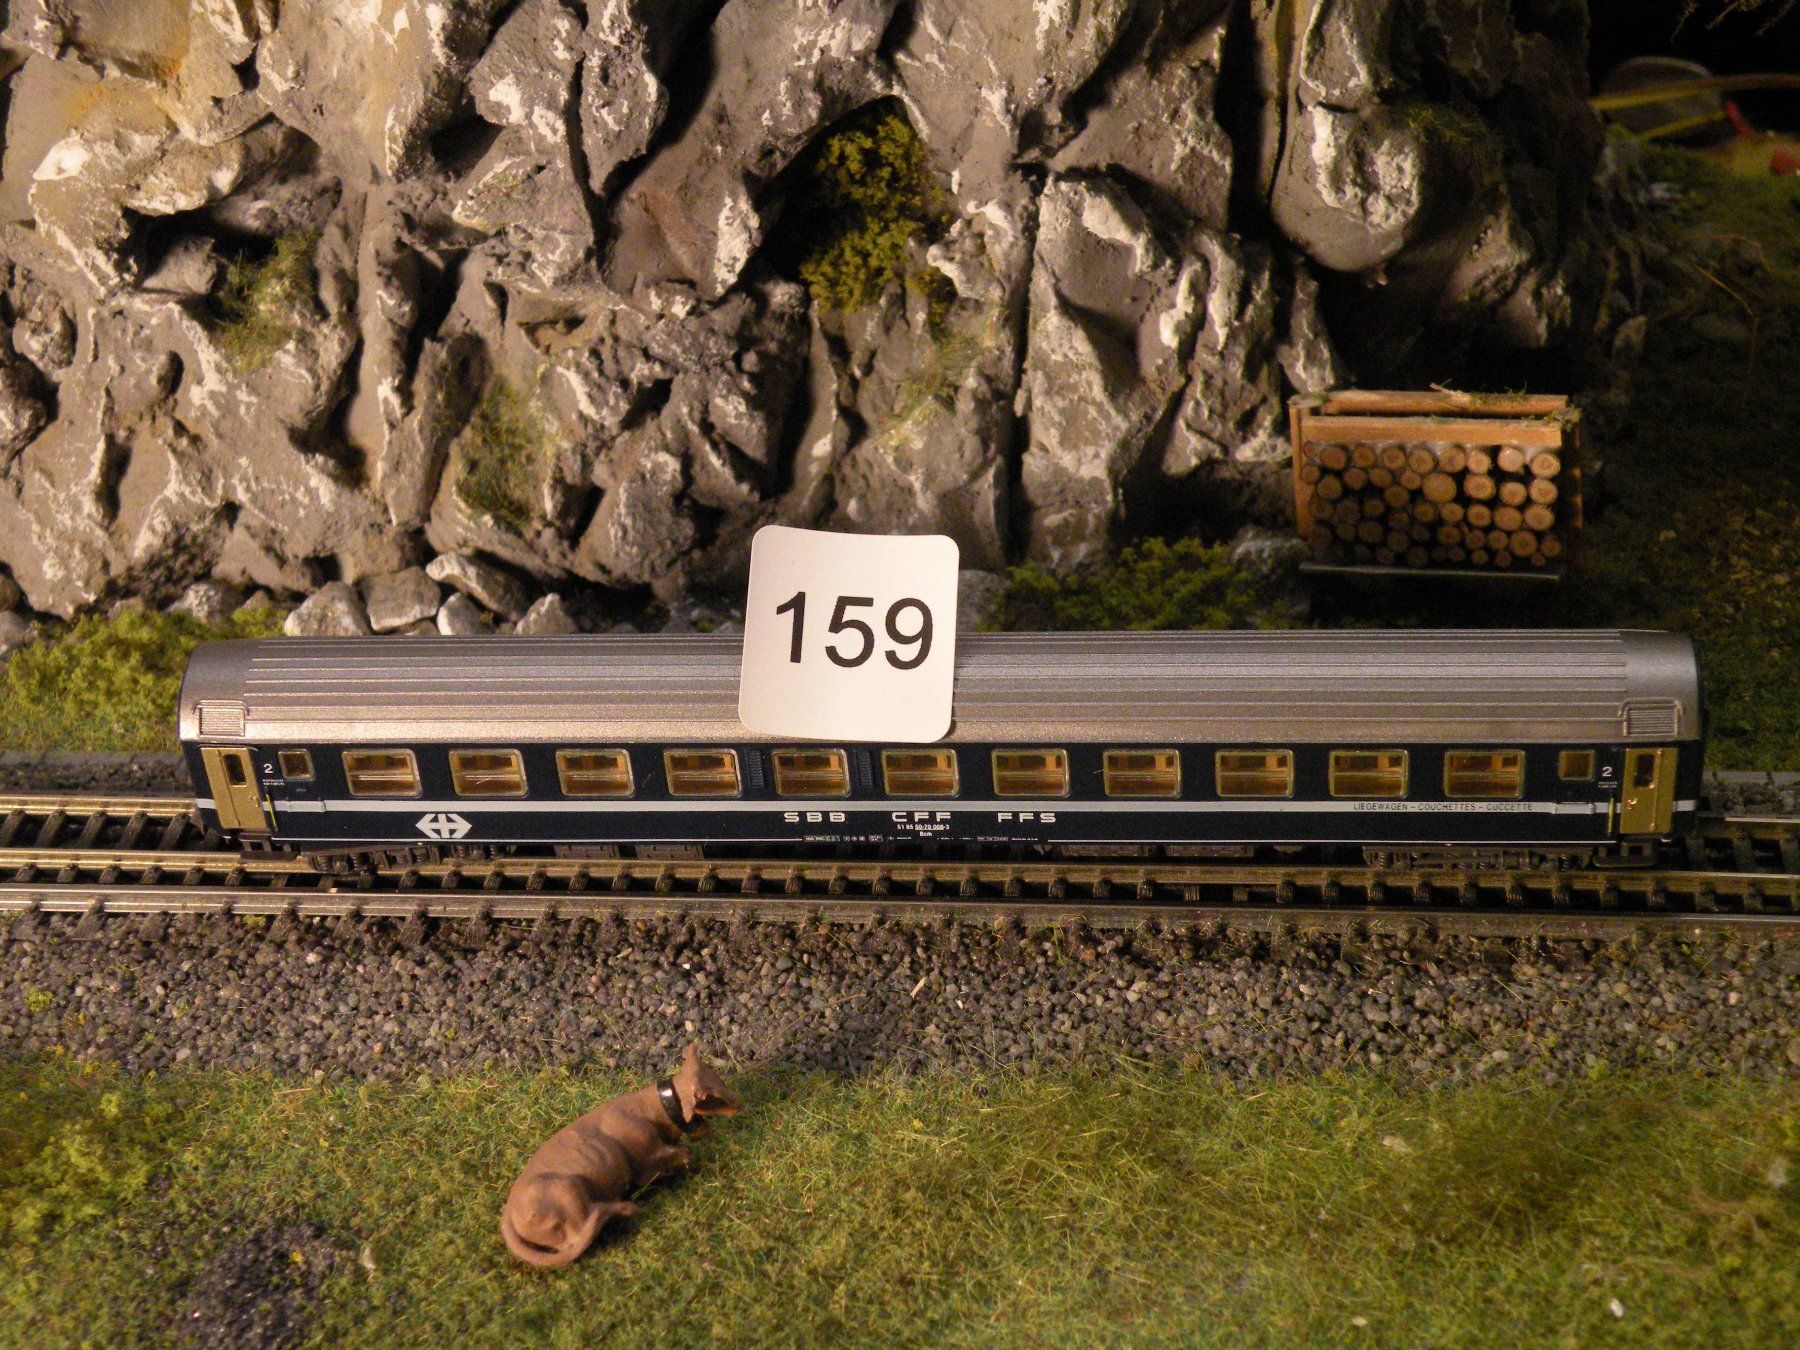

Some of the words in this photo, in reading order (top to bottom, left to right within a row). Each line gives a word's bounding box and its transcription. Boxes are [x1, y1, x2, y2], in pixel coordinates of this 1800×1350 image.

[776, 591, 933, 670] 159
[263, 763, 274, 774] 2
[1602, 766, 1613, 777] 2
[1353, 802, 1408, 811] LIEGEWAGEN
[1418, 802, 1476, 811] COUCHETTES
[1486, 802, 1533, 811] CUCCETTE
[784, 812, 846, 823] SBB
[892, 812, 951, 822] CFF
[998, 812, 1056, 823] FFS
